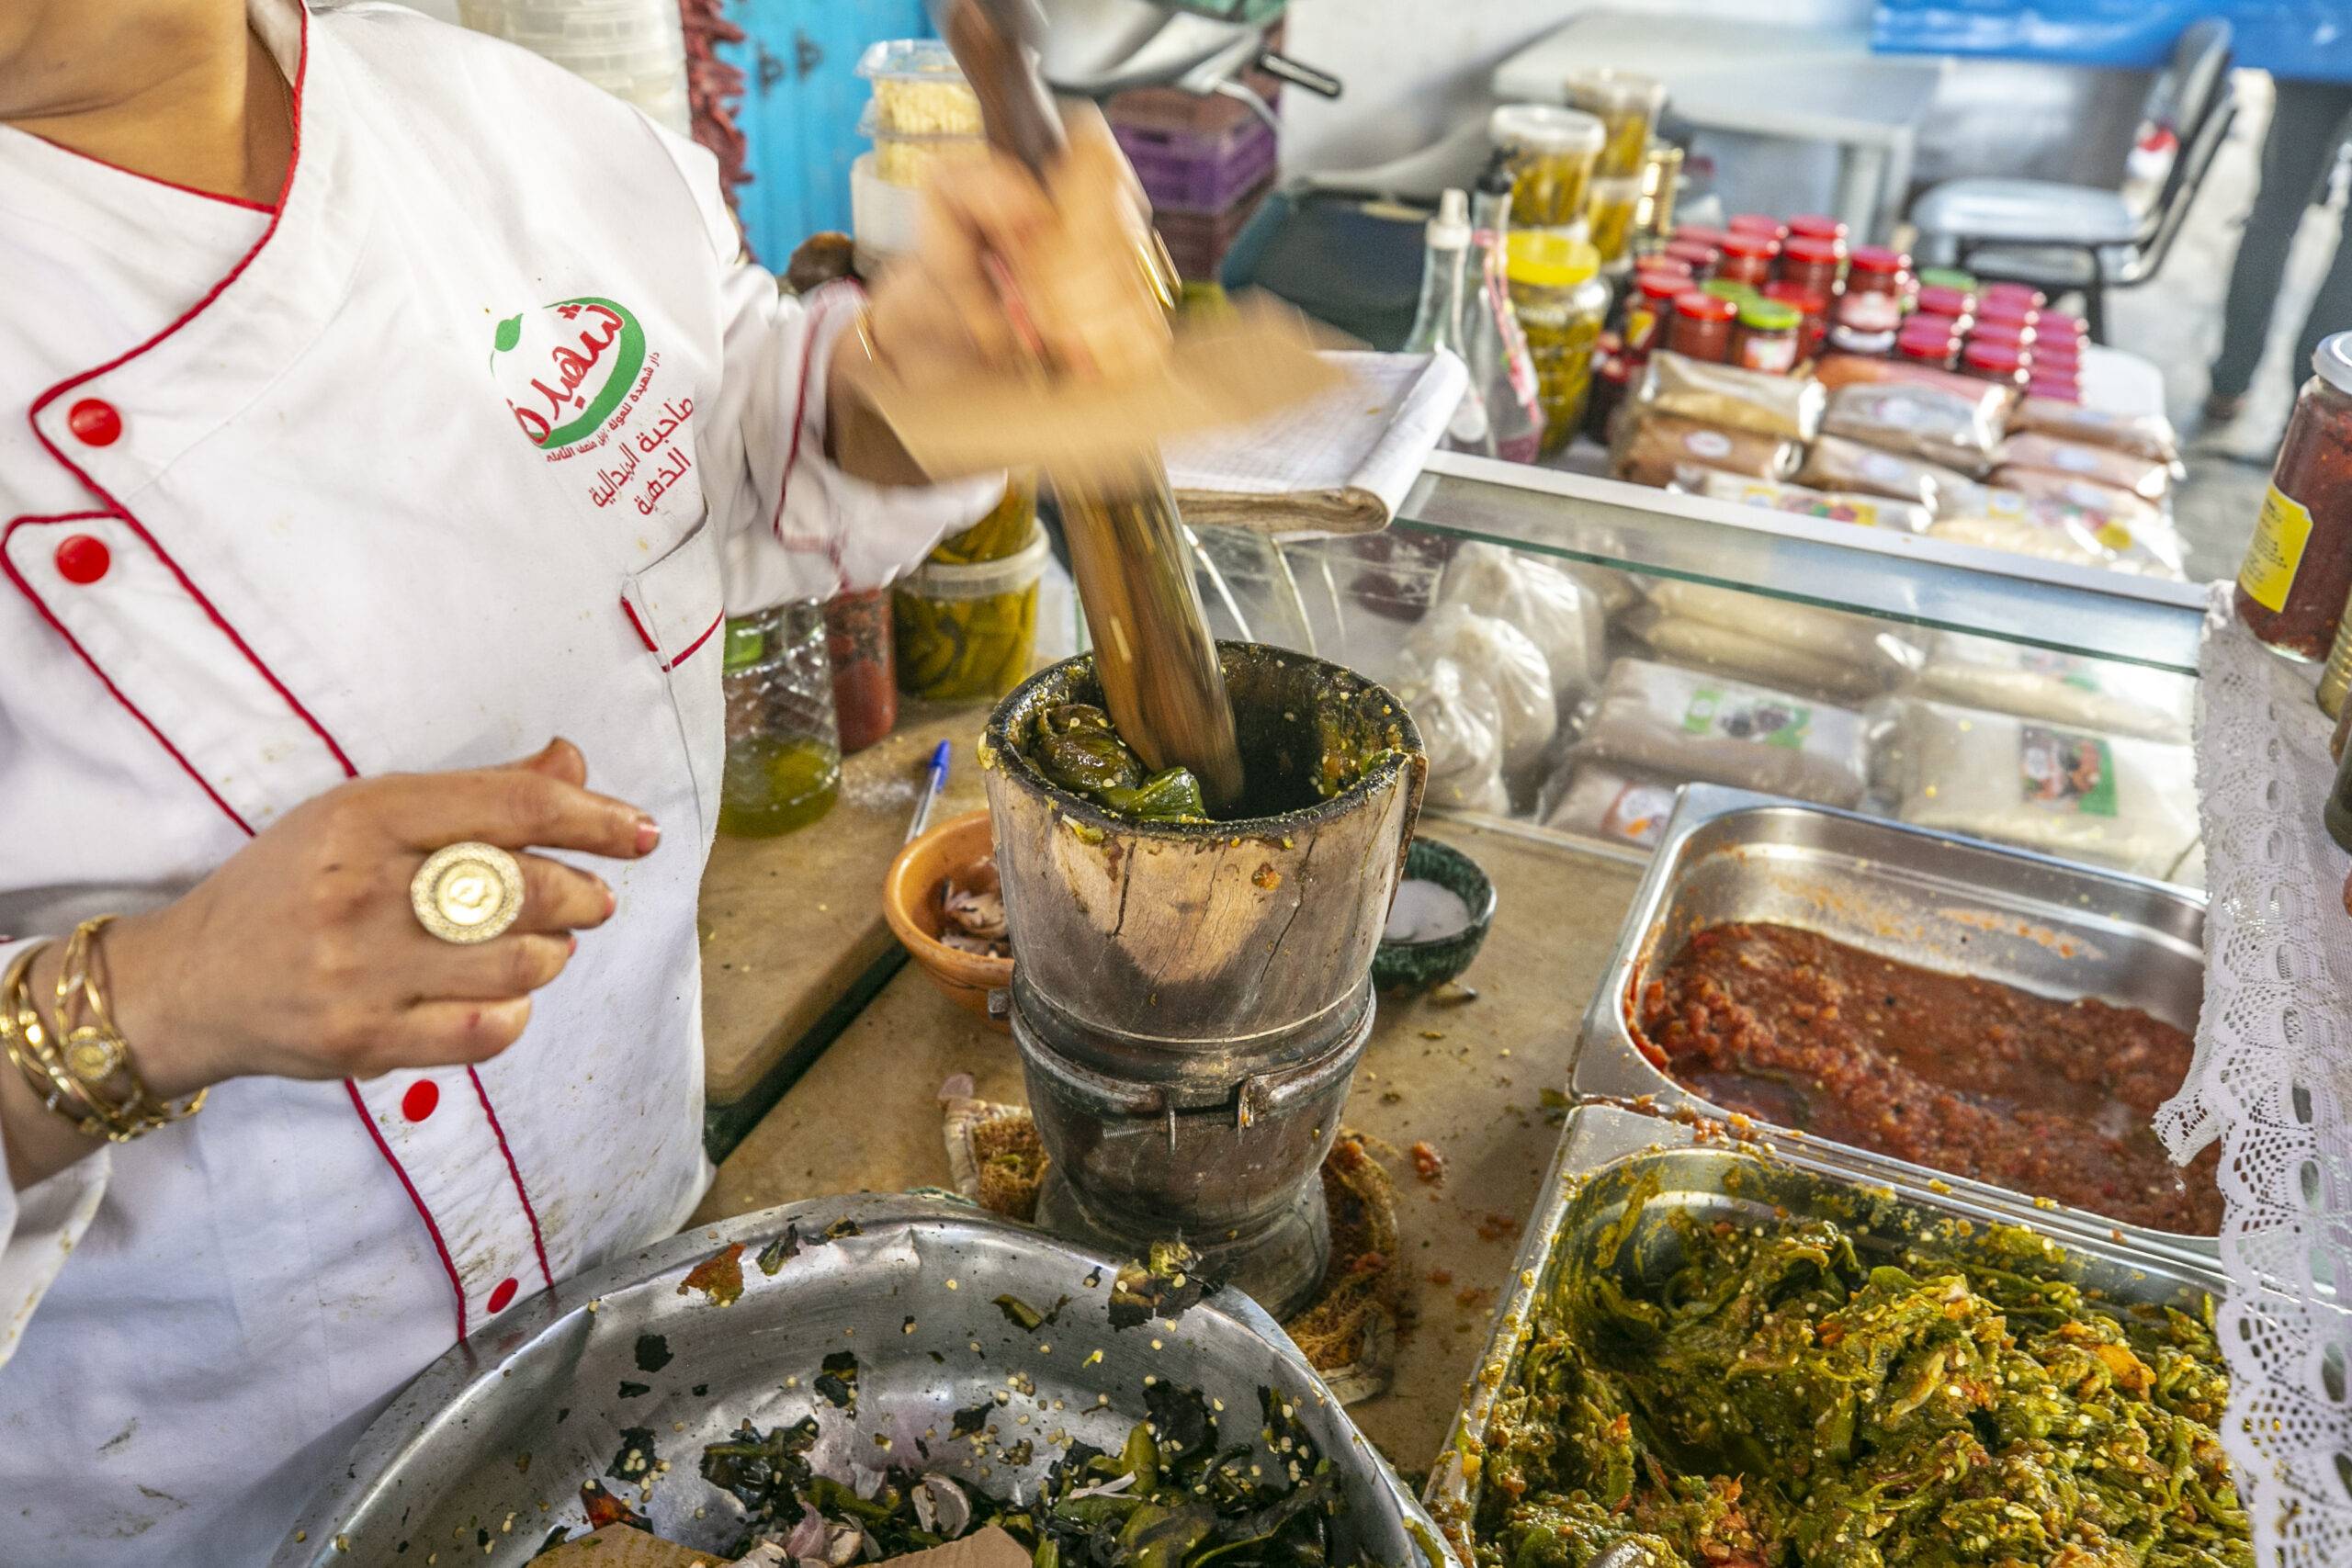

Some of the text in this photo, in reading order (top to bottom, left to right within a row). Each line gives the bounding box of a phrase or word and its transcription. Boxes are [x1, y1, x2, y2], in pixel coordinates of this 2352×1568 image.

[649, 352, 661, 367] دار
[630, 367, 654, 402] شهيدة
[589, 399, 694, 507] صاحبة الميدالية
